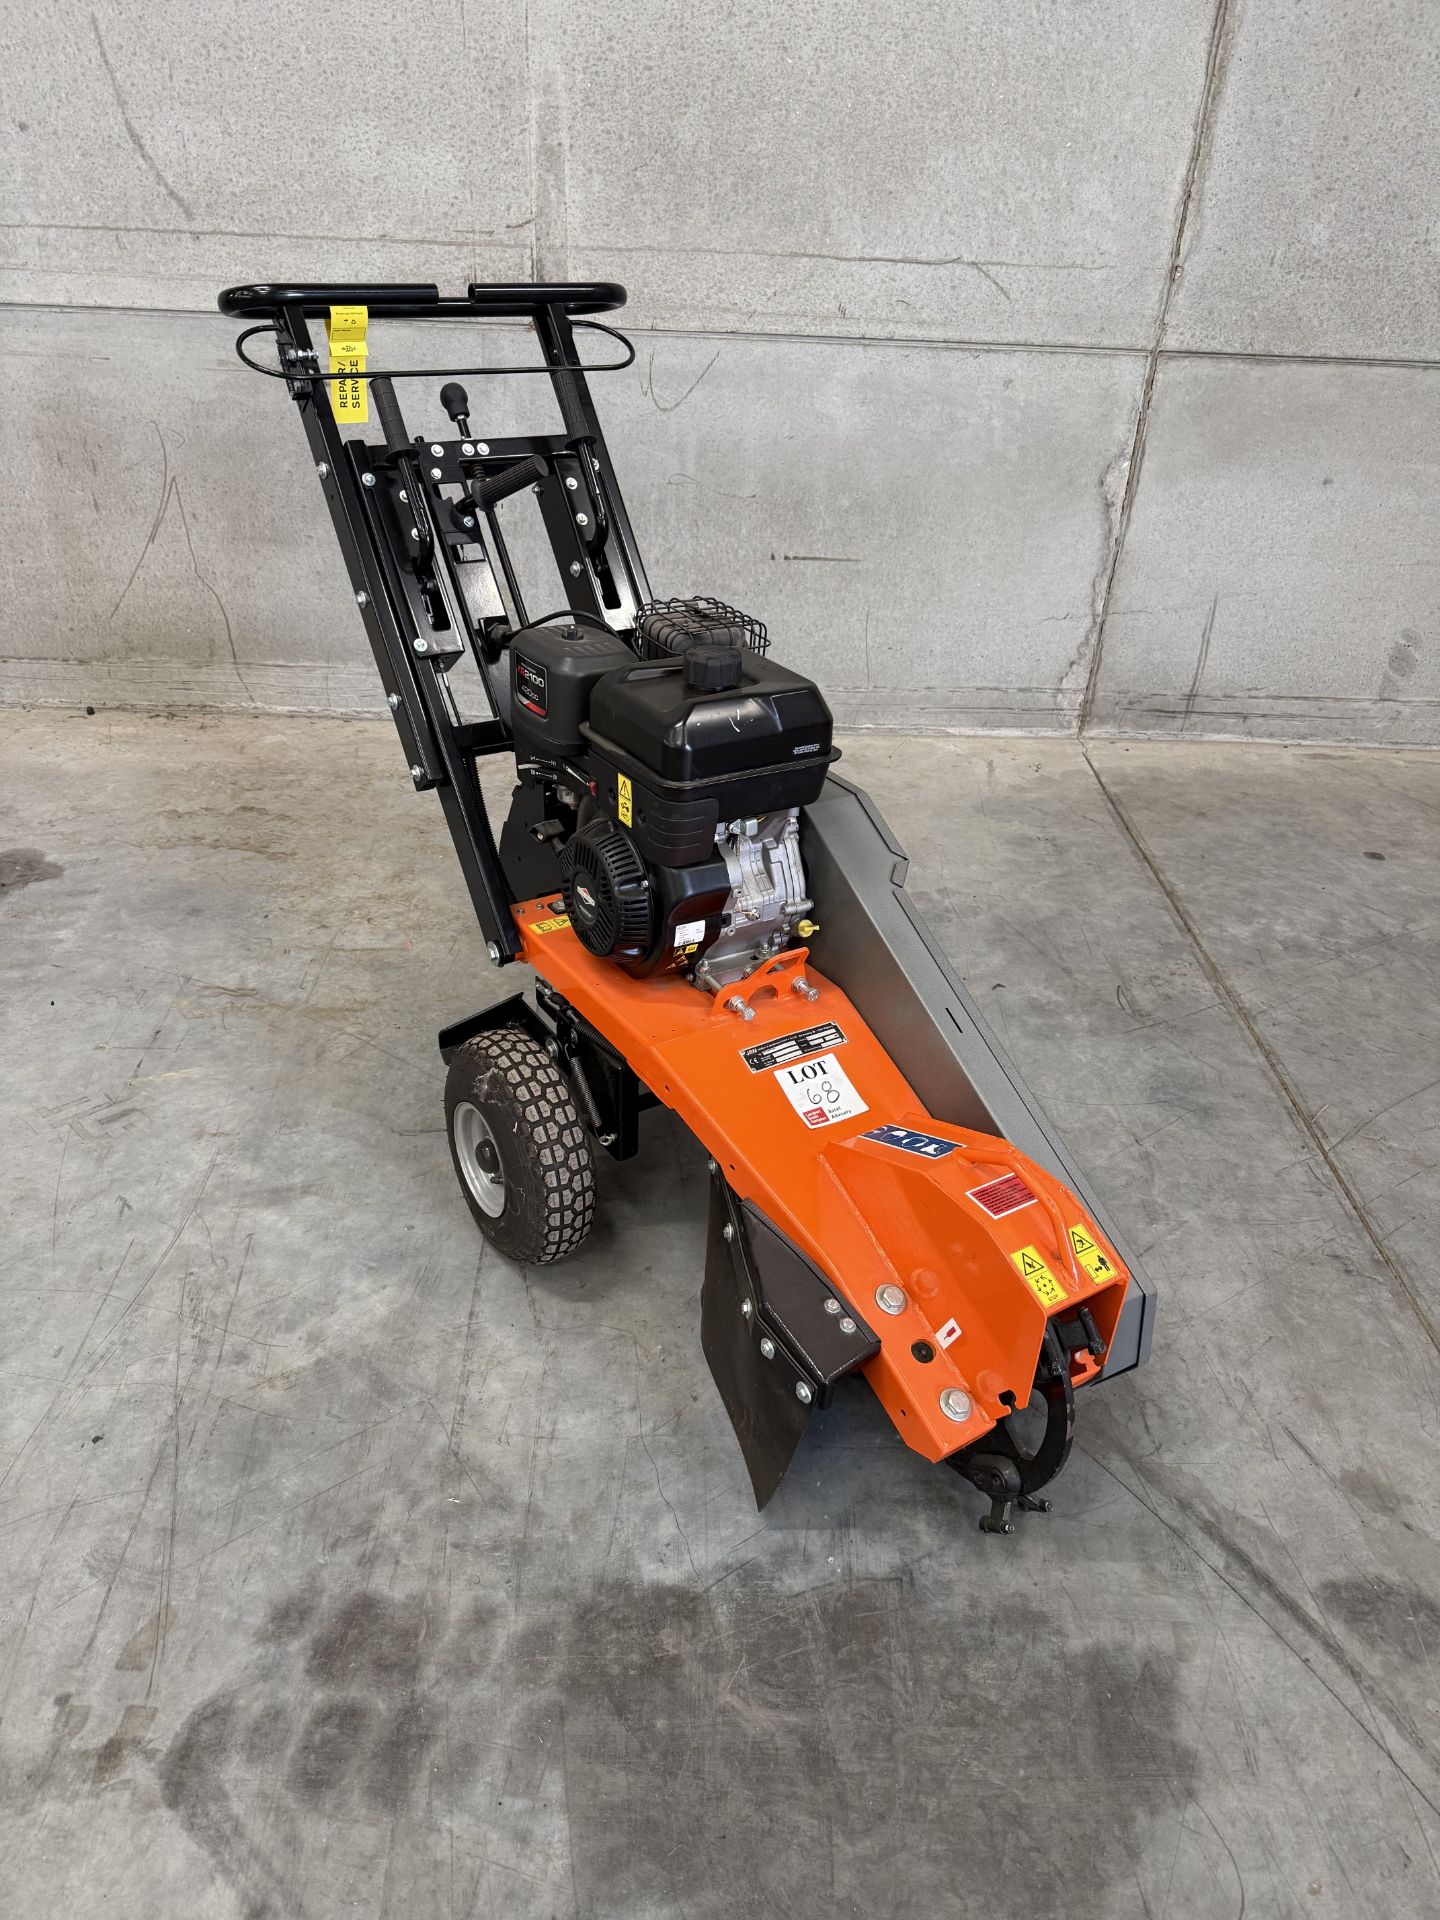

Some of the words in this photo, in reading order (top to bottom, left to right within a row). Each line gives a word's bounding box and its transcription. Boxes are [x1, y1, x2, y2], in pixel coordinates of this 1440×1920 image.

[337, 361, 348, 408] REPAR/
[350, 360, 361, 409] SERVCE
[787, 1060, 829, 1085] LOT
[807, 1081, 840, 1105] 68
